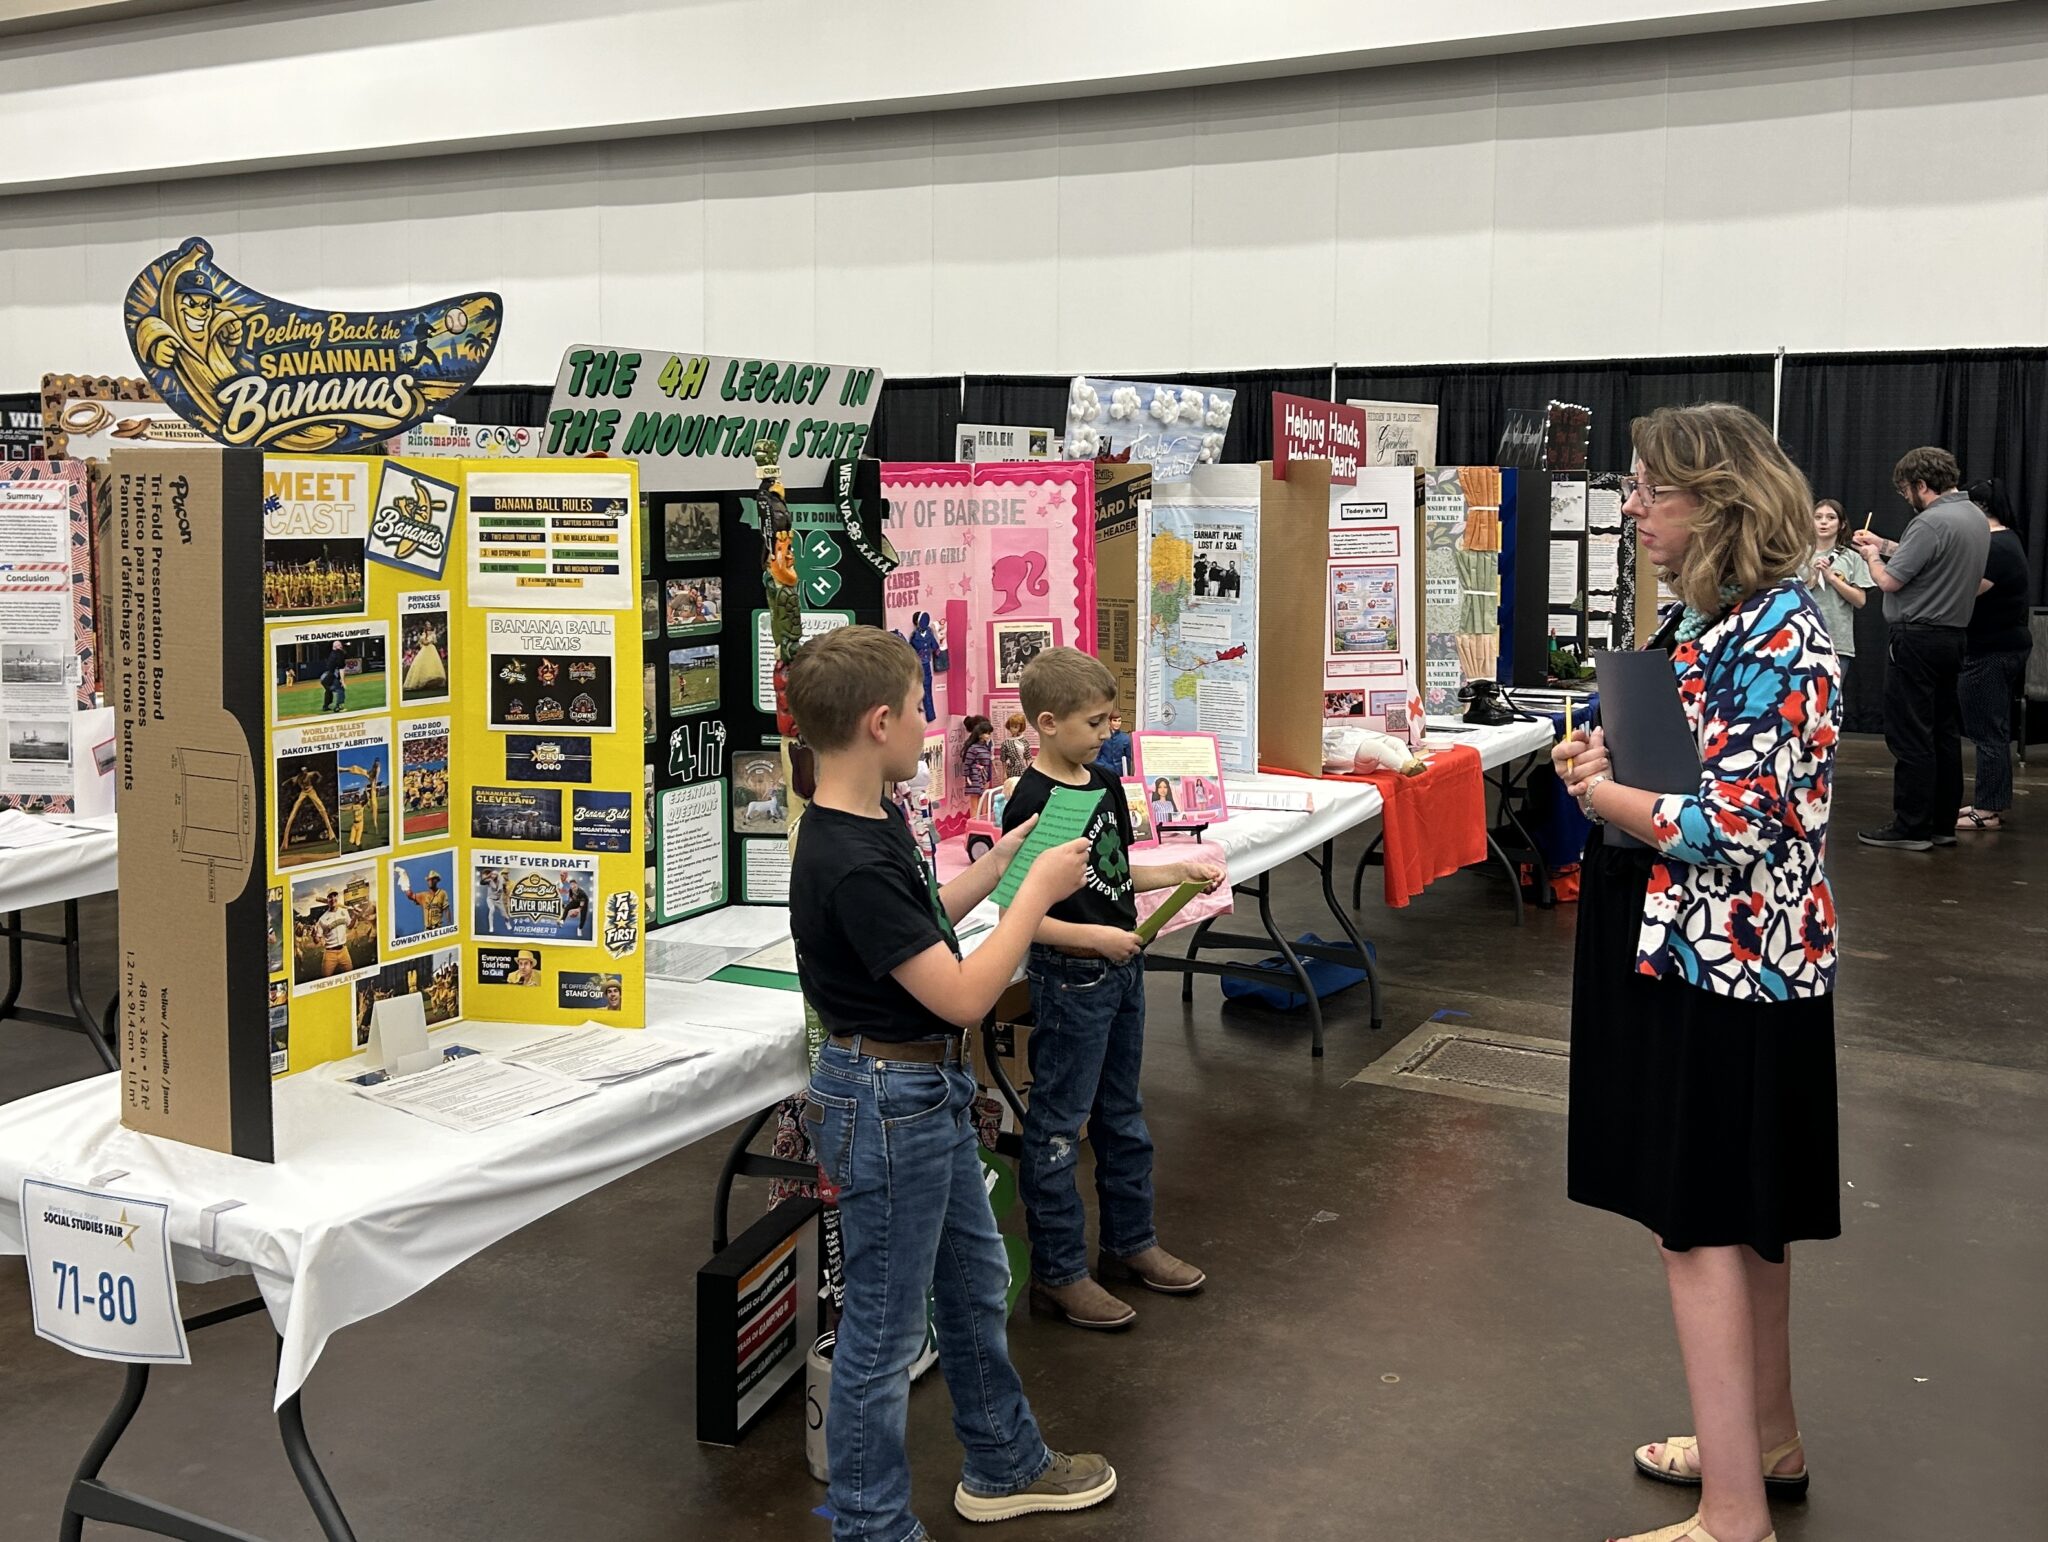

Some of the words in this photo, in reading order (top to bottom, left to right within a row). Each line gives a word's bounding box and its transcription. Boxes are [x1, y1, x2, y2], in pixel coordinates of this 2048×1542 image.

[246, 312, 325, 349] Peeling
[328, 313, 379, 342] Back
[381, 320, 401, 339] the
[260, 348, 397, 379] SAVANNAH
[568, 350, 642, 399] THE
[657, 355, 710, 400] 4H
[720, 359, 831, 405] LEGACY
[839, 367, 875, 407] IN
[217, 373, 415, 446] Bananas
[164, 430, 205, 439] HISTORY
[547, 408, 622, 456] THE
[621, 411, 790, 458] MOUNTAIN
[788, 417, 870, 460] STATE
[1285, 403, 1325, 449] Helping
[1329, 411, 1361, 449] Hands,
[978, 431, 1014, 447] HELEN
[1327, 445, 1357, 478] Hearts
[265, 472, 356, 502] MEET
[838, 463, 853, 497] WEST
[6, 492, 43, 501] Summary
[494, 497, 533, 511] BANANA
[536, 498, 560, 511] BALL
[562, 499, 593, 512] RULES
[120, 474, 131, 550] Panneau
[151, 473, 164, 540] Tri-Fold
[169, 475, 193, 545] Pacon
[913, 499, 937, 528] OF
[943, 498, 1027, 528] BARBIE
[265, 503, 356, 535] CAST
[796, 511, 811, 522] BY
[373, 508, 442, 549] Bananas
[1104, 520, 1137, 539] HEADER
[1193, 530, 1221, 540] EARHART
[1223, 531, 1243, 541] PLANE
[1198, 540, 1214, 550] LOST
[1215, 541, 1224, 550] AT
[1225, 542, 1238, 550] SEA
[924, 549, 937, 566] ON
[940, 547, 968, 564] GIRLS
[134, 547, 145, 586] para
[6, 574, 50, 582] Conclusion
[886, 570, 921, 591] CAREER
[120, 555, 133, 650] d'affichage
[152, 547, 164, 660] Presentation
[407, 594, 441, 602] PRINCESS
[407, 602, 441, 610] POTASSIA
[886, 590, 919, 609] CLOSET
[295, 633, 310, 642] THE
[311, 630, 345, 641] DANCING
[345, 628, 371, 638] UMPIRE
[491, 619, 564, 634] BANANA
[566, 620, 611, 635] BALL
[521, 635, 581, 651] TEAMS
[134, 592, 148, 727] presentaciones
[123, 674, 133, 713] trois
[152, 667, 165, 720] Board
[571, 711, 595, 719] CLOWNS
[301, 724, 334, 736] WORLD'S
[335, 721, 366, 732] TALLEST
[403, 730, 427, 739] CHEER
[427, 728, 450, 737] SQUAD
[412, 722, 428, 730] DAD
[428, 721, 442, 729] BOD
[281, 746, 313, 756] DAKOTA
[345, 736, 384, 748] ALBRITTON
[301, 732, 338, 744] BASEBALL
[338, 729, 367, 740] PLAYER
[123, 719, 135, 791] battants
[475, 795, 537, 805] CLEVELAND
[669, 797, 719, 822] QUESTIONS
[574, 807, 607, 821] Banana
[605, 808, 630, 822] Ball
[480, 855, 503, 865] THE
[520, 857, 550, 867] EVER
[551, 858, 591, 869] DRAFT
[510, 899, 536, 913] PLAYER
[537, 900, 560, 914] DRAFT
[614, 892, 631, 921] FAN
[390, 933, 421, 948] COWBOY
[421, 930, 439, 941] KYLE
[439, 924, 459, 938] LUIGS
[513, 925, 550, 934] NOVEMBER
[481, 954, 512, 962] Everyone
[482, 961, 497, 969] Told
[127, 973, 134, 985] m
[139, 980, 148, 999] 48
[565, 990, 588, 998] STAND
[160, 988, 168, 1021] Yellow
[127, 1002, 136, 1028] 91.4
[128, 1030, 134, 1051] cm
[140, 1029, 149, 1046] 36
[140, 1047, 147, 1058] in
[161, 1031, 170, 1075] Amarillo
[141, 1079, 149, 1093] 12
[161, 1084, 170, 1115] Jaune
[44, 1211, 71, 1228] SOCIAL
[71, 1217, 104, 1235] STUDIES
[104, 1224, 123, 1238] FAIR
[52, 1260, 138, 1325] 71-80
